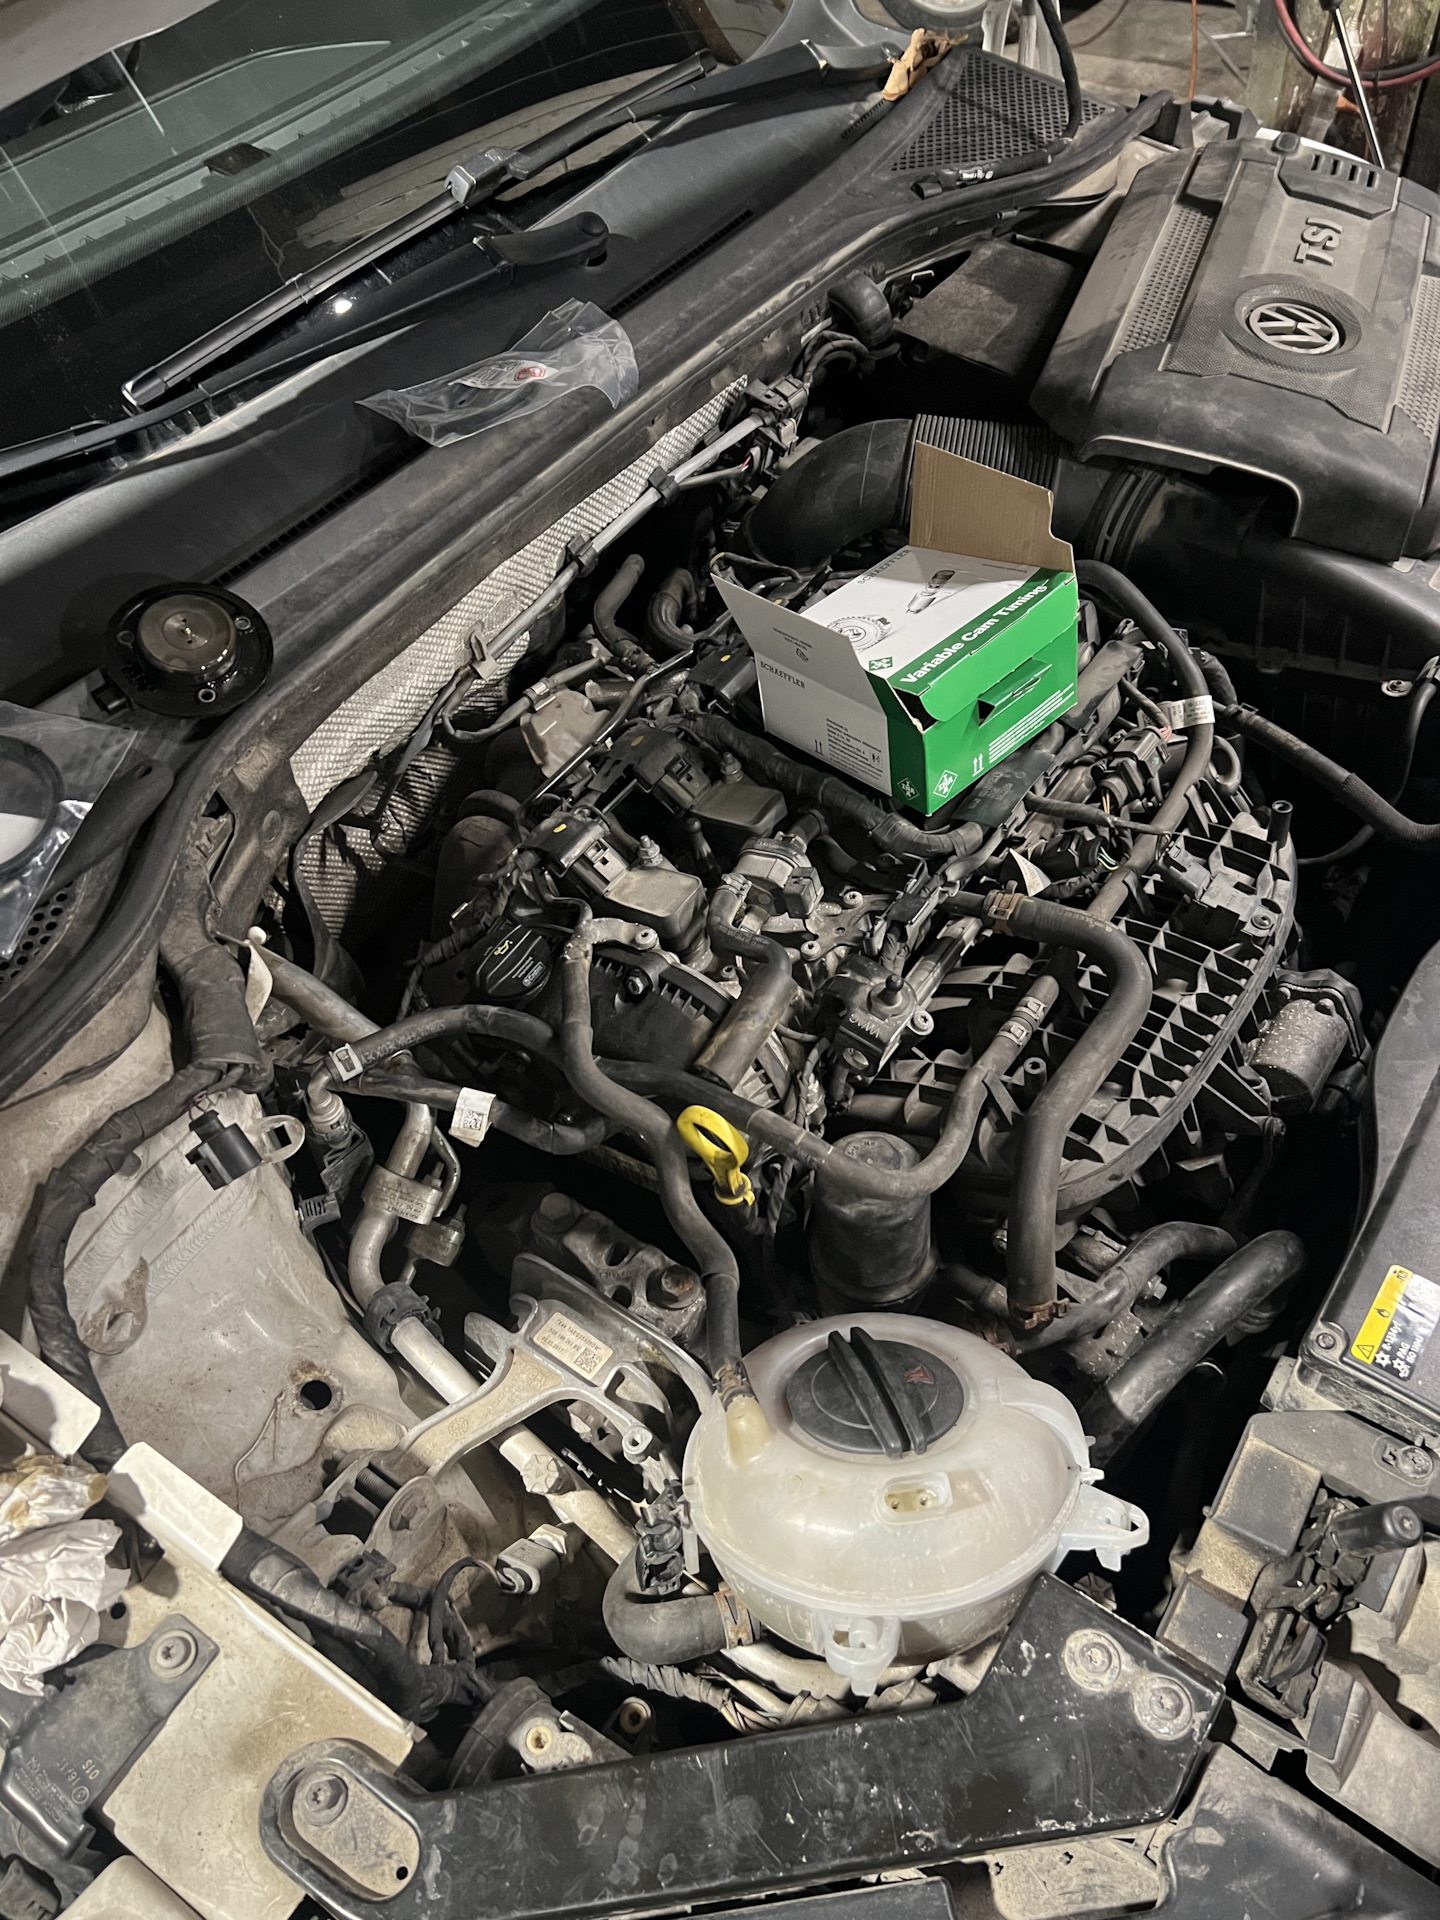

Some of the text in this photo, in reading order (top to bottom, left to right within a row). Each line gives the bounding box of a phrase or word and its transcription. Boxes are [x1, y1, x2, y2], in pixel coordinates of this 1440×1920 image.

[1295, 217, 1343, 266] TSI
[857, 549, 911, 584] SCHAEFFLER
[899, 642, 965, 683] Variable
[961, 618, 1000, 642] Cam
[760, 660, 806, 689] SCHAEFFLER
[1396, 1341, 1410, 1359] PAG
